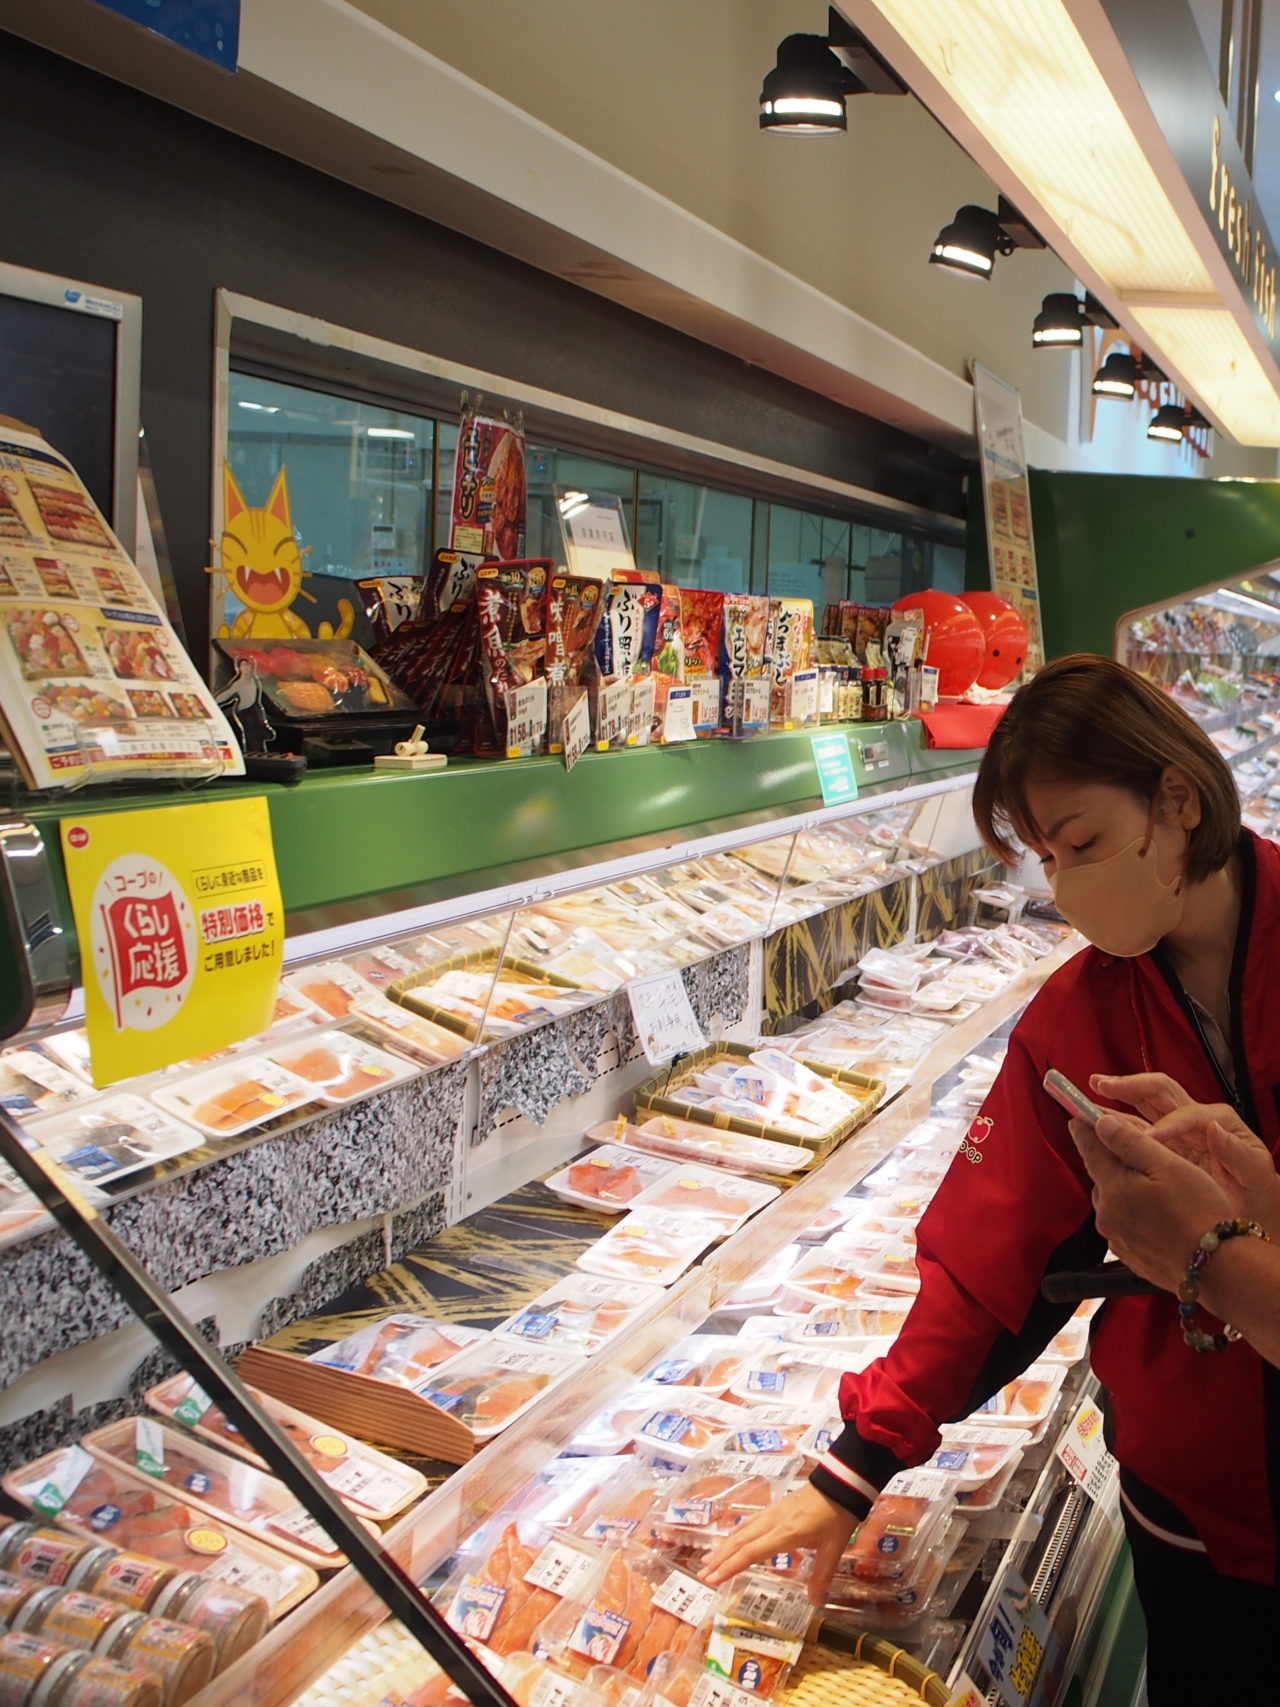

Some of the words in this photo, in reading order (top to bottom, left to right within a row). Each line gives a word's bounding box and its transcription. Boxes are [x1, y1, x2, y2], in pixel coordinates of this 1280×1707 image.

[117, 871, 157, 892] コープの
[123, 902, 170, 939] くらし
[128, 936, 181, 984] 応援
